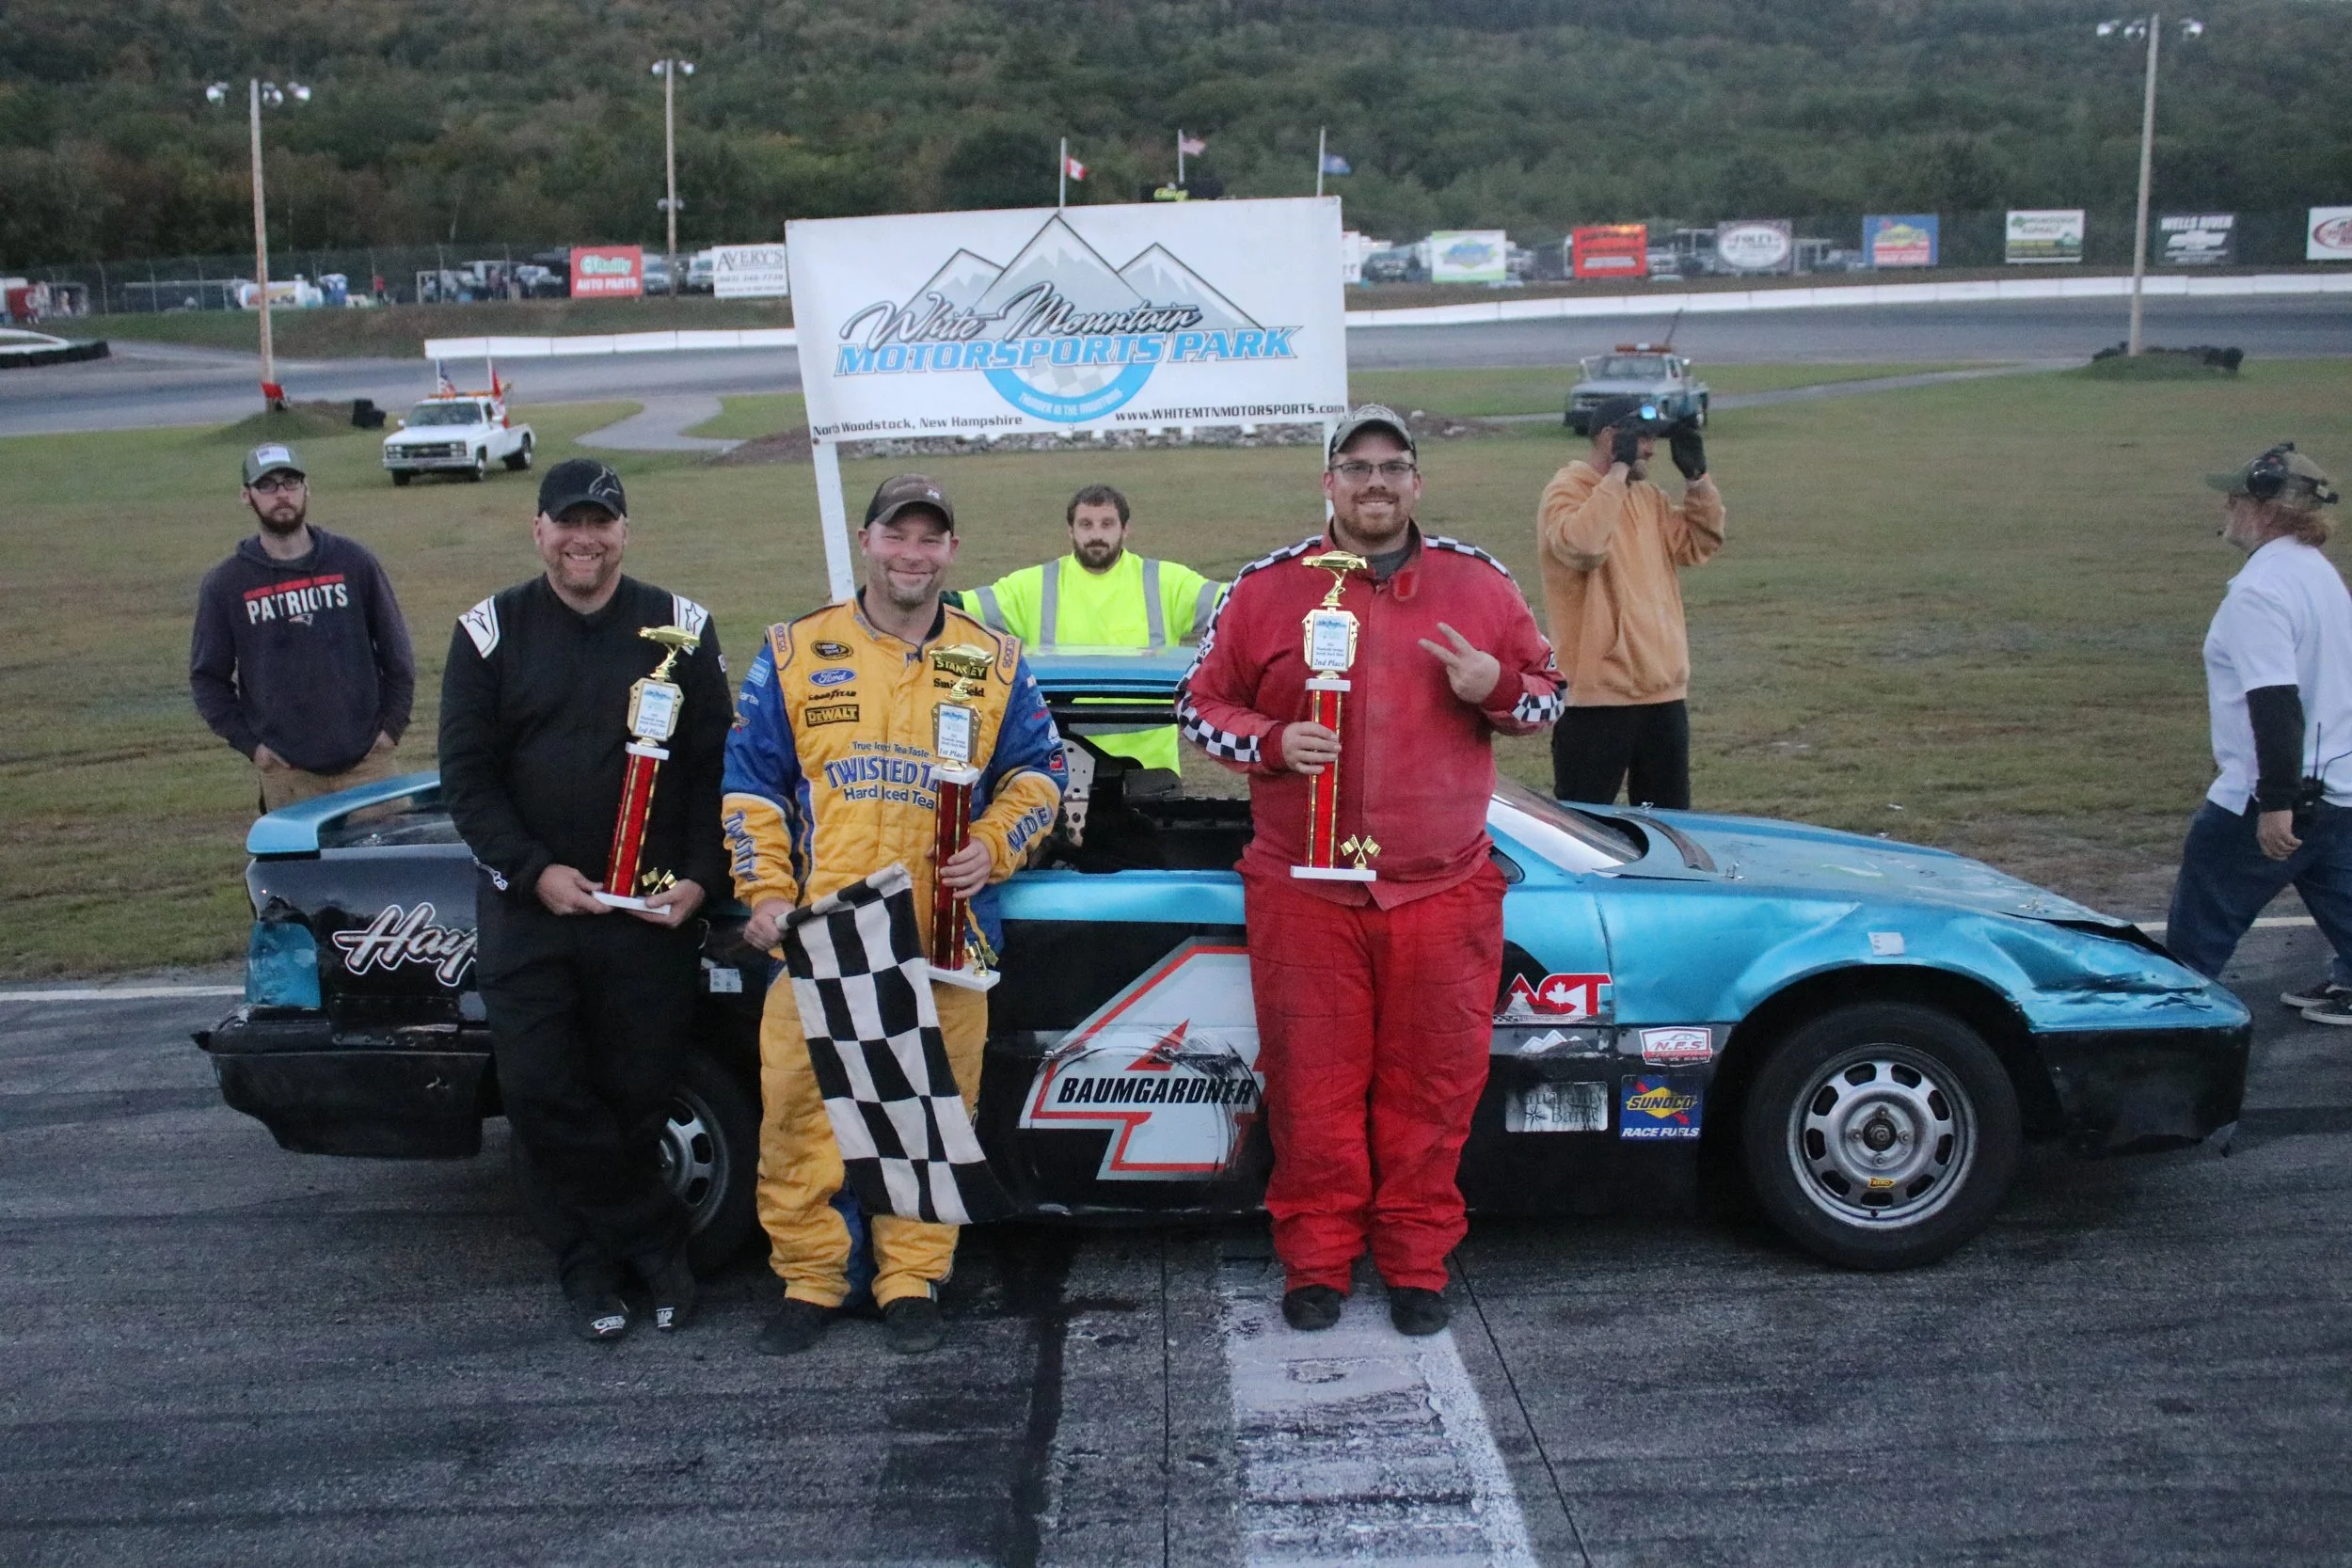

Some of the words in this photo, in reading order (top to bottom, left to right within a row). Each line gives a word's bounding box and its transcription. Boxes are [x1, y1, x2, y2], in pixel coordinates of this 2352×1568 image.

[717, 249, 786, 271] AVERY'S
[839, 292, 988, 352] White
[997, 281, 1203, 342] Mountain
[834, 331, 1167, 377] MOTORSPORTS
[1167, 325, 1304, 363] PARK
[1116, 403, 1345, 421] www.WHITEMTNMOTORSPORTS.com
[813, 424, 840, 436] North
[842, 418, 915, 433] Woodstock,
[920, 417, 947, 429] New
[951, 415, 1023, 428] Hampshire
[246, 582, 349, 626] PATRIOTS
[818, 669, 848, 684] Ford
[936, 658, 986, 677] STANEY
[852, 741, 871, 752] True
[875, 741, 891, 752] Iced
[894, 744, 907, 754] Tea
[909, 746, 930, 758] Taste
[950, 750, 967, 759] Place
[824, 755, 918, 788] TWISTED
[844, 784, 878, 800] Hard
[882, 785, 909, 801] Iced
[912, 790, 935, 810] Tea
[334, 903, 478, 986] Hay
[1494, 973, 1613, 1016] ACT
[1057, 1077, 1254, 1105] BAUMGARDNER
[1629, 1096, 1694, 1109] SUNOCO
[1622, 1128, 1660, 1137] RACE
[1660, 1127, 1700, 1137] FUELS
